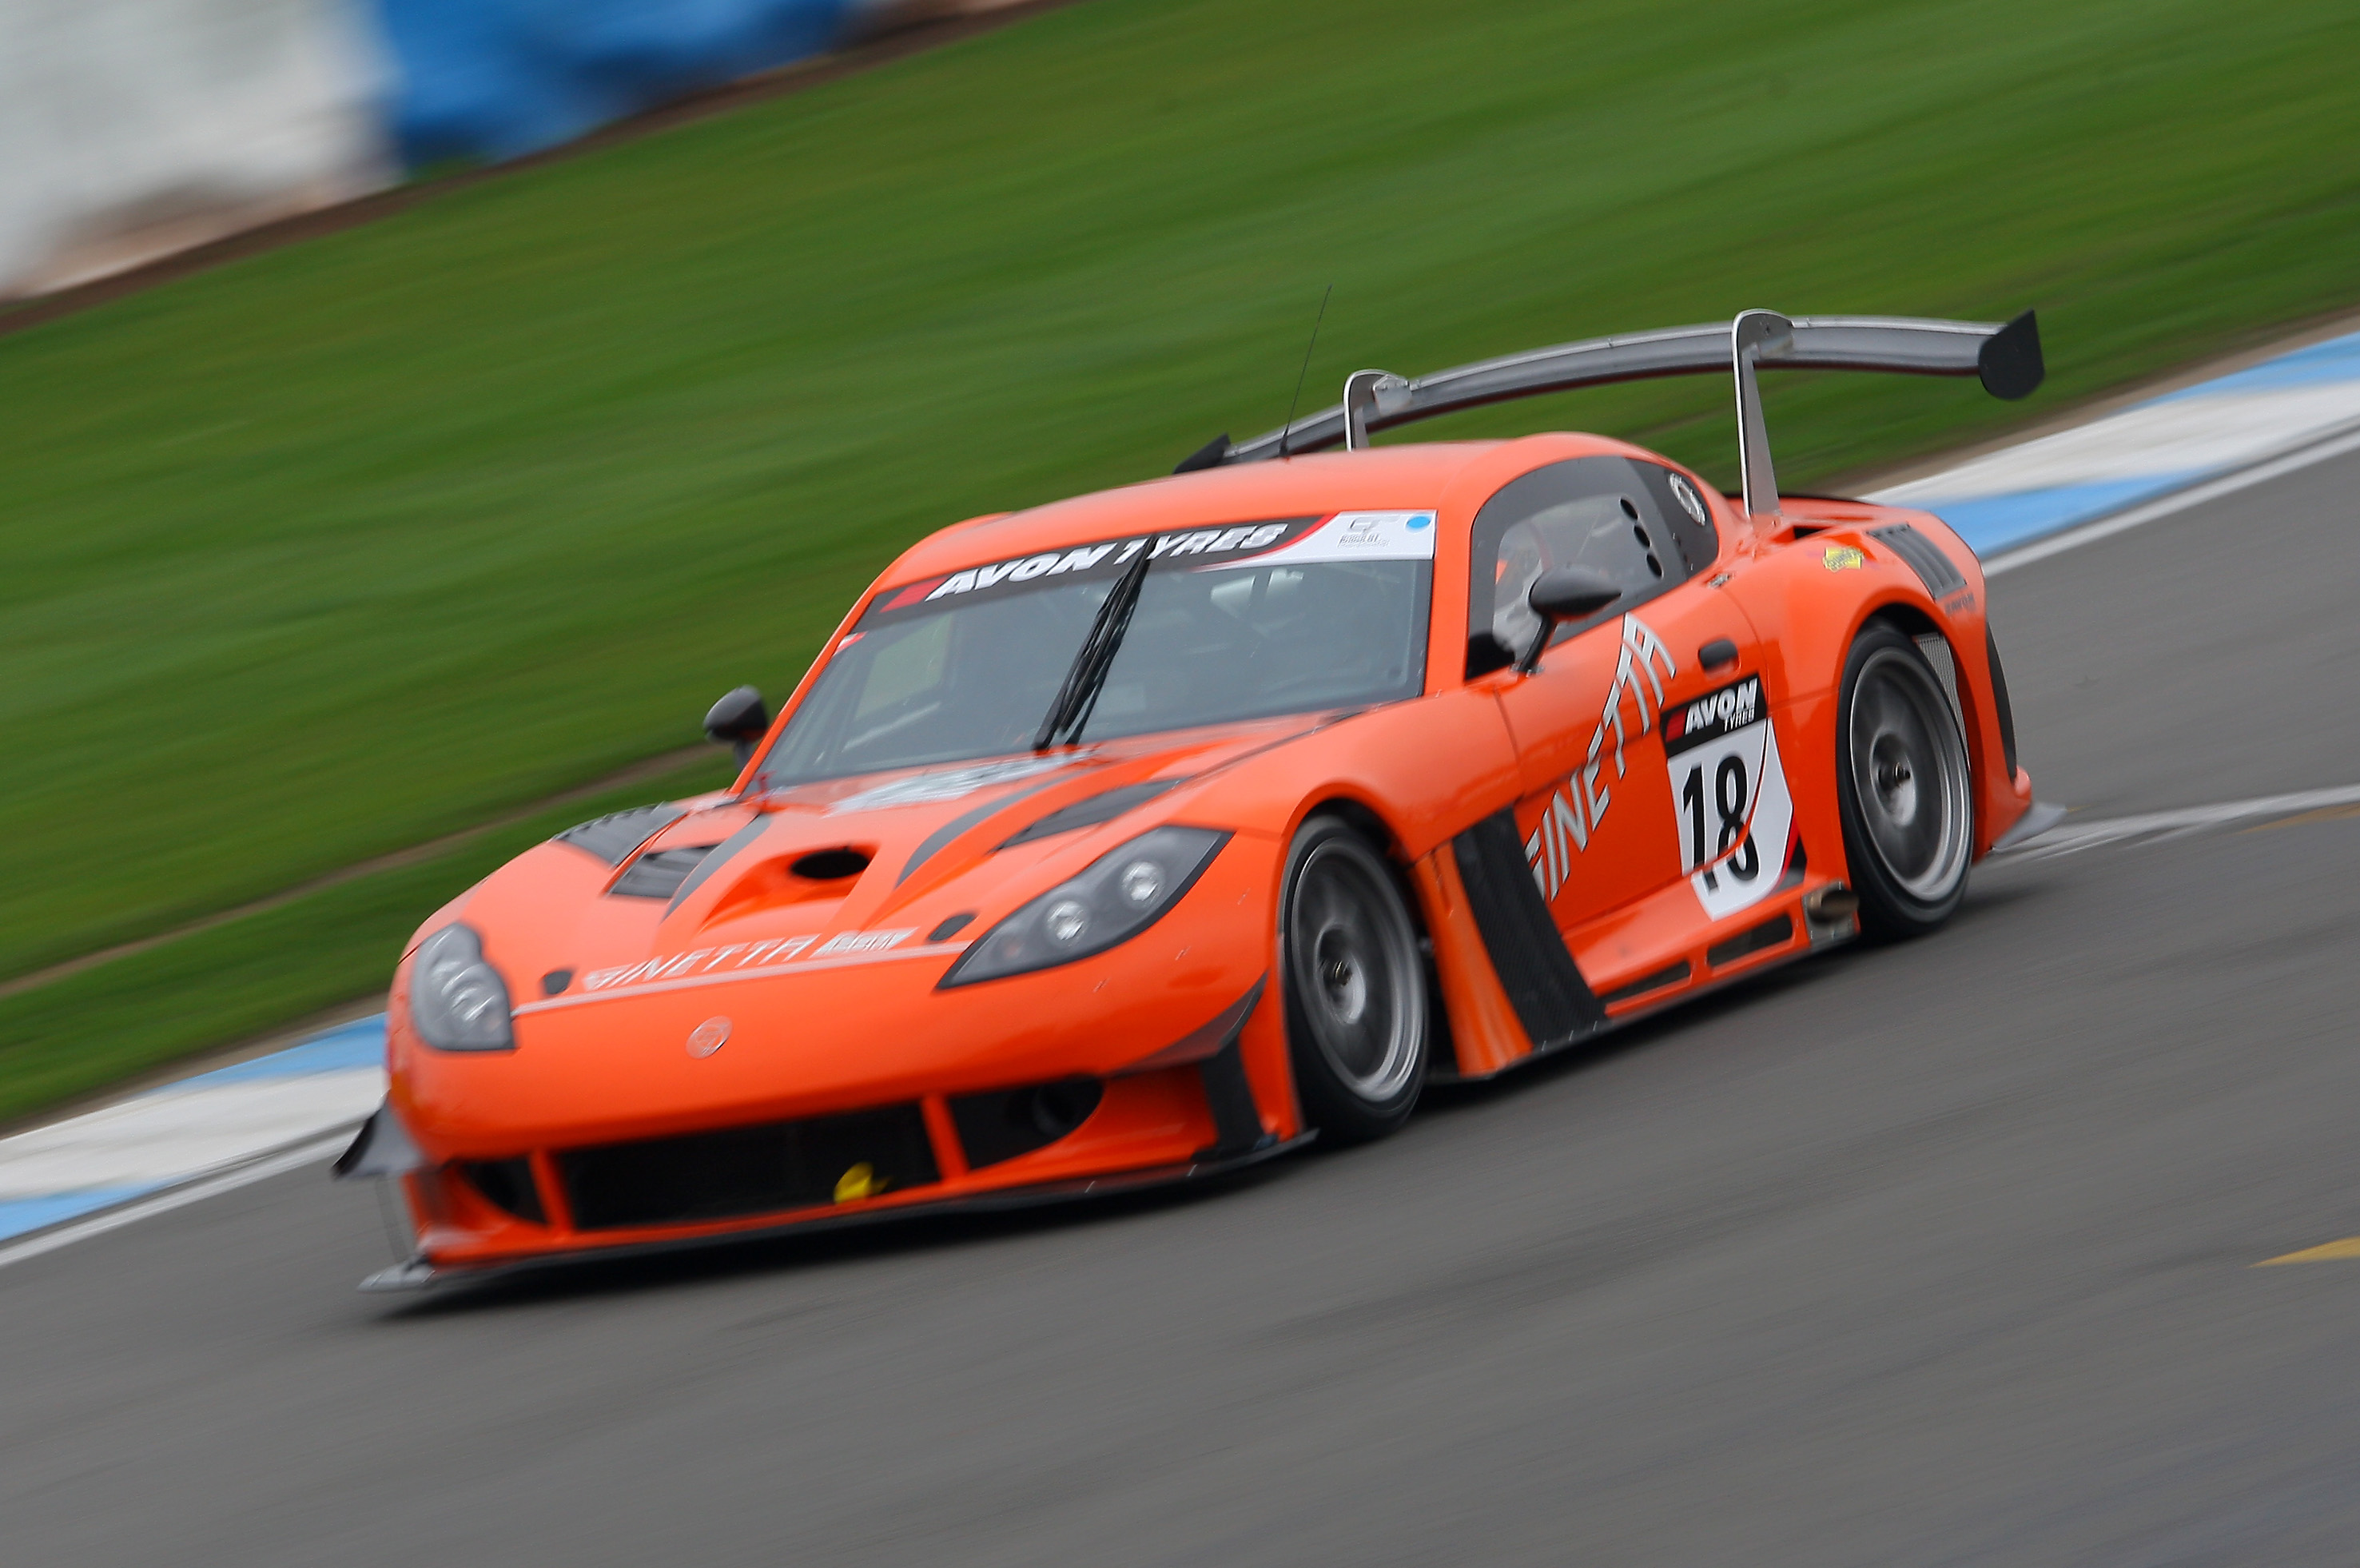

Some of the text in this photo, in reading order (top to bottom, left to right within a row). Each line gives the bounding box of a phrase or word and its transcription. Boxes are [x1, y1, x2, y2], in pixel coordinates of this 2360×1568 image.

[925, 522, 1289, 603] AVON TYRES
[1684, 677, 1758, 736] AVON
[1681, 755, 1760, 893] 18
[582, 932, 822, 992] GINETTA
